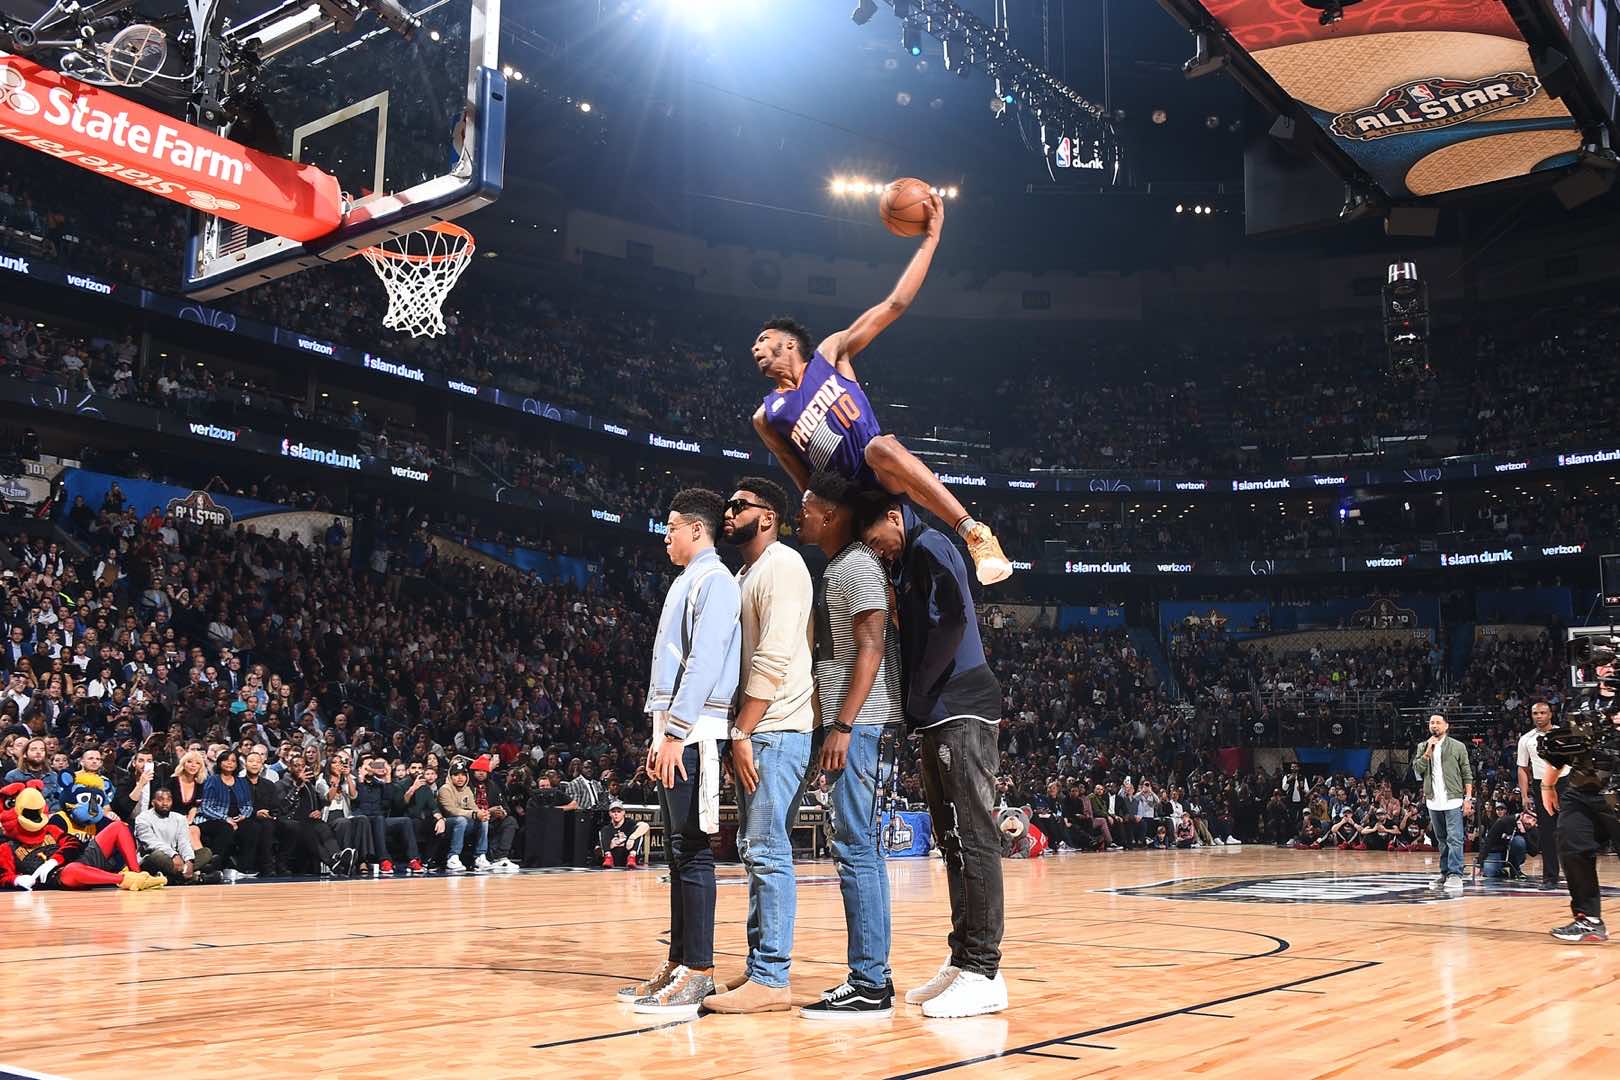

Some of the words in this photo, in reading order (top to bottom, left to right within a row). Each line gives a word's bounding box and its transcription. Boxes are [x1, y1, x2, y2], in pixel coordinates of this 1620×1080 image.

[67, 274, 111, 294] verizon
[298, 338, 333, 355] verizon
[447, 380, 478, 395] verizon
[791, 374, 847, 452] PHOENIX
[831, 393, 861, 429] 10
[189, 422, 236, 442] verizon
[603, 423, 628, 437] verizon
[722, 449, 750, 460] verizon
[390, 466, 429, 482] verizon
[1494, 462, 1527, 472] verizon
[1008, 480, 1036, 489] verizon
[1175, 481, 1206, 490] verizon
[1313, 475, 1345, 485] verizon
[591, 509, 621, 524] verizon
[1541, 544, 1582, 556] verizon
[1156, 562, 1192, 572] verizon
[1365, 557, 1402, 568] verizon
